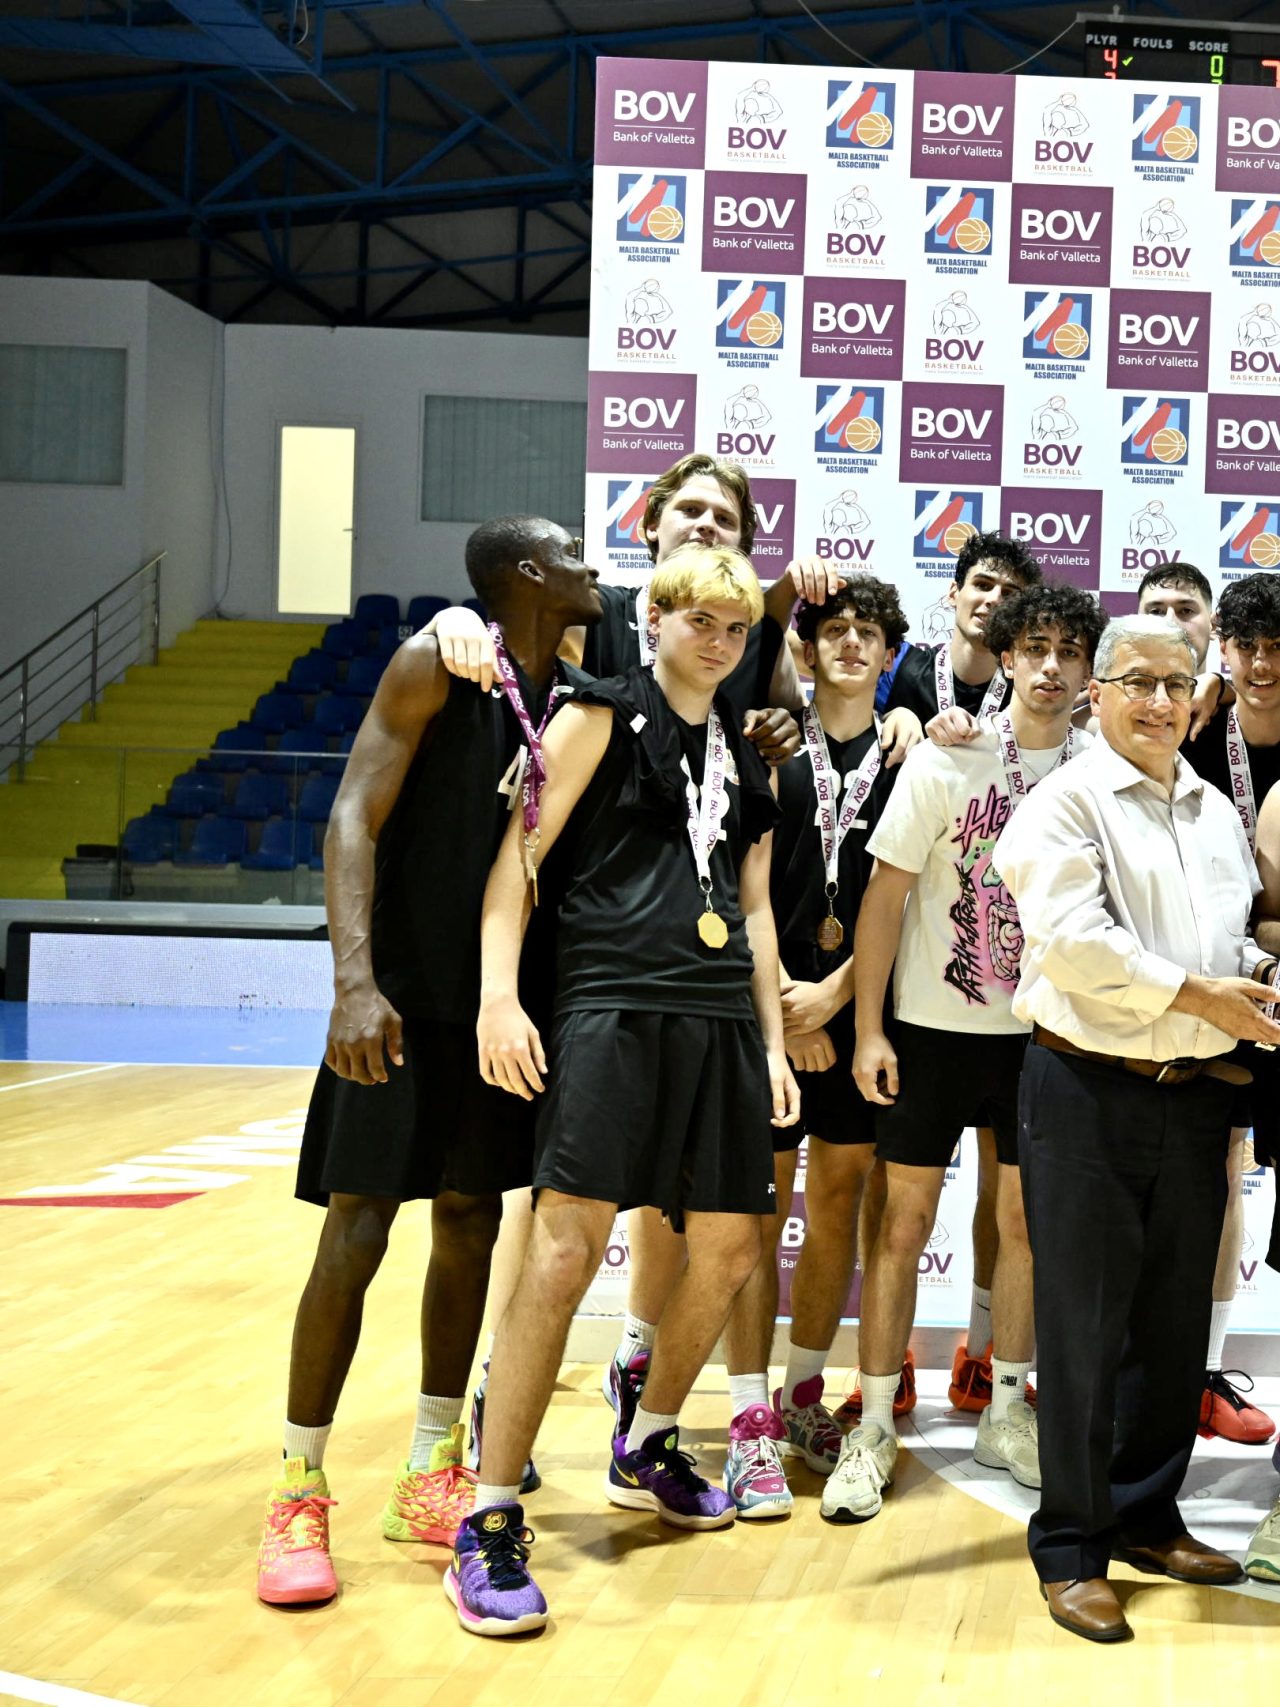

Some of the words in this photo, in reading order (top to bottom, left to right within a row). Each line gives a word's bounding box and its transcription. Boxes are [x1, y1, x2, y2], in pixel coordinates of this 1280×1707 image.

[1086, 34, 1118, 46] PLYR
[1133, 37, 1173, 49] FOULS
[1188, 41, 1229, 53] SCORE
[1104, 49, 1118, 70] 4
[1210, 55, 1223, 77] 0
[614, 90, 696, 122] BOV
[922, 103, 1003, 136] BOV
[613, 131, 639, 141] Bank
[641, 132, 652, 142] of
[654, 133, 695, 144] Valletta
[728, 126, 787, 150] BOV
[727, 151, 785, 159] BASKETBALL
[850, 153, 889, 161] BASKETBALL
[922, 144, 947, 154] Bank
[949, 145, 961, 155] of
[962, 146, 1002, 157] Valletta
[837, 160, 880, 169] ASSOCIATION
[1134, 165, 1154, 173] MALTA
[1155, 166, 1194, 175] BASKETBALL
[1227, 158, 1251, 168] Bank
[1253, 158, 1265, 169] of
[1142, 174, 1185, 182] ASSOCIATION
[713, 196, 795, 228] BOV
[713, 237, 738, 247] Bank
[740, 238, 752, 248] of
[754, 239, 794, 250] Valletta
[1133, 245, 1191, 268] BOV
[1132, 269, 1189, 277] BASKETBALL
[812, 302, 894, 334] BOV
[617, 327, 677, 350] BOV
[812, 343, 837, 353] Bank
[839, 343, 851, 354] of
[852, 345, 893, 356] Valletta
[617, 351, 674, 359] BASKETBALL
[1024, 443, 1082, 466] BOV
[1216, 460, 1241, 470] Bank
[1243, 460, 1254, 471] of
[1023, 467, 1080, 475] BASKETBALL
[1010, 512, 1091, 544] BOV
[1036, 553, 1048, 564] of
[1050, 555, 1090, 566] Valletta
[501, 657, 517, 682] BOV
[511, 687, 526, 713] BOV
[522, 718, 540, 743] BOV
[809, 726, 818, 745] BOV
[814, 751, 825, 771] BOV
[1005, 740, 1019, 765] BOV
[1229, 742, 1240, 765] BOV
[817, 777, 828, 801] BOV
[853, 779, 870, 804] BOV
[1012, 770, 1026, 795] BOV
[1234, 773, 1245, 797] BOV
[822, 807, 831, 831] BOV
[840, 806, 856, 831] BOV
